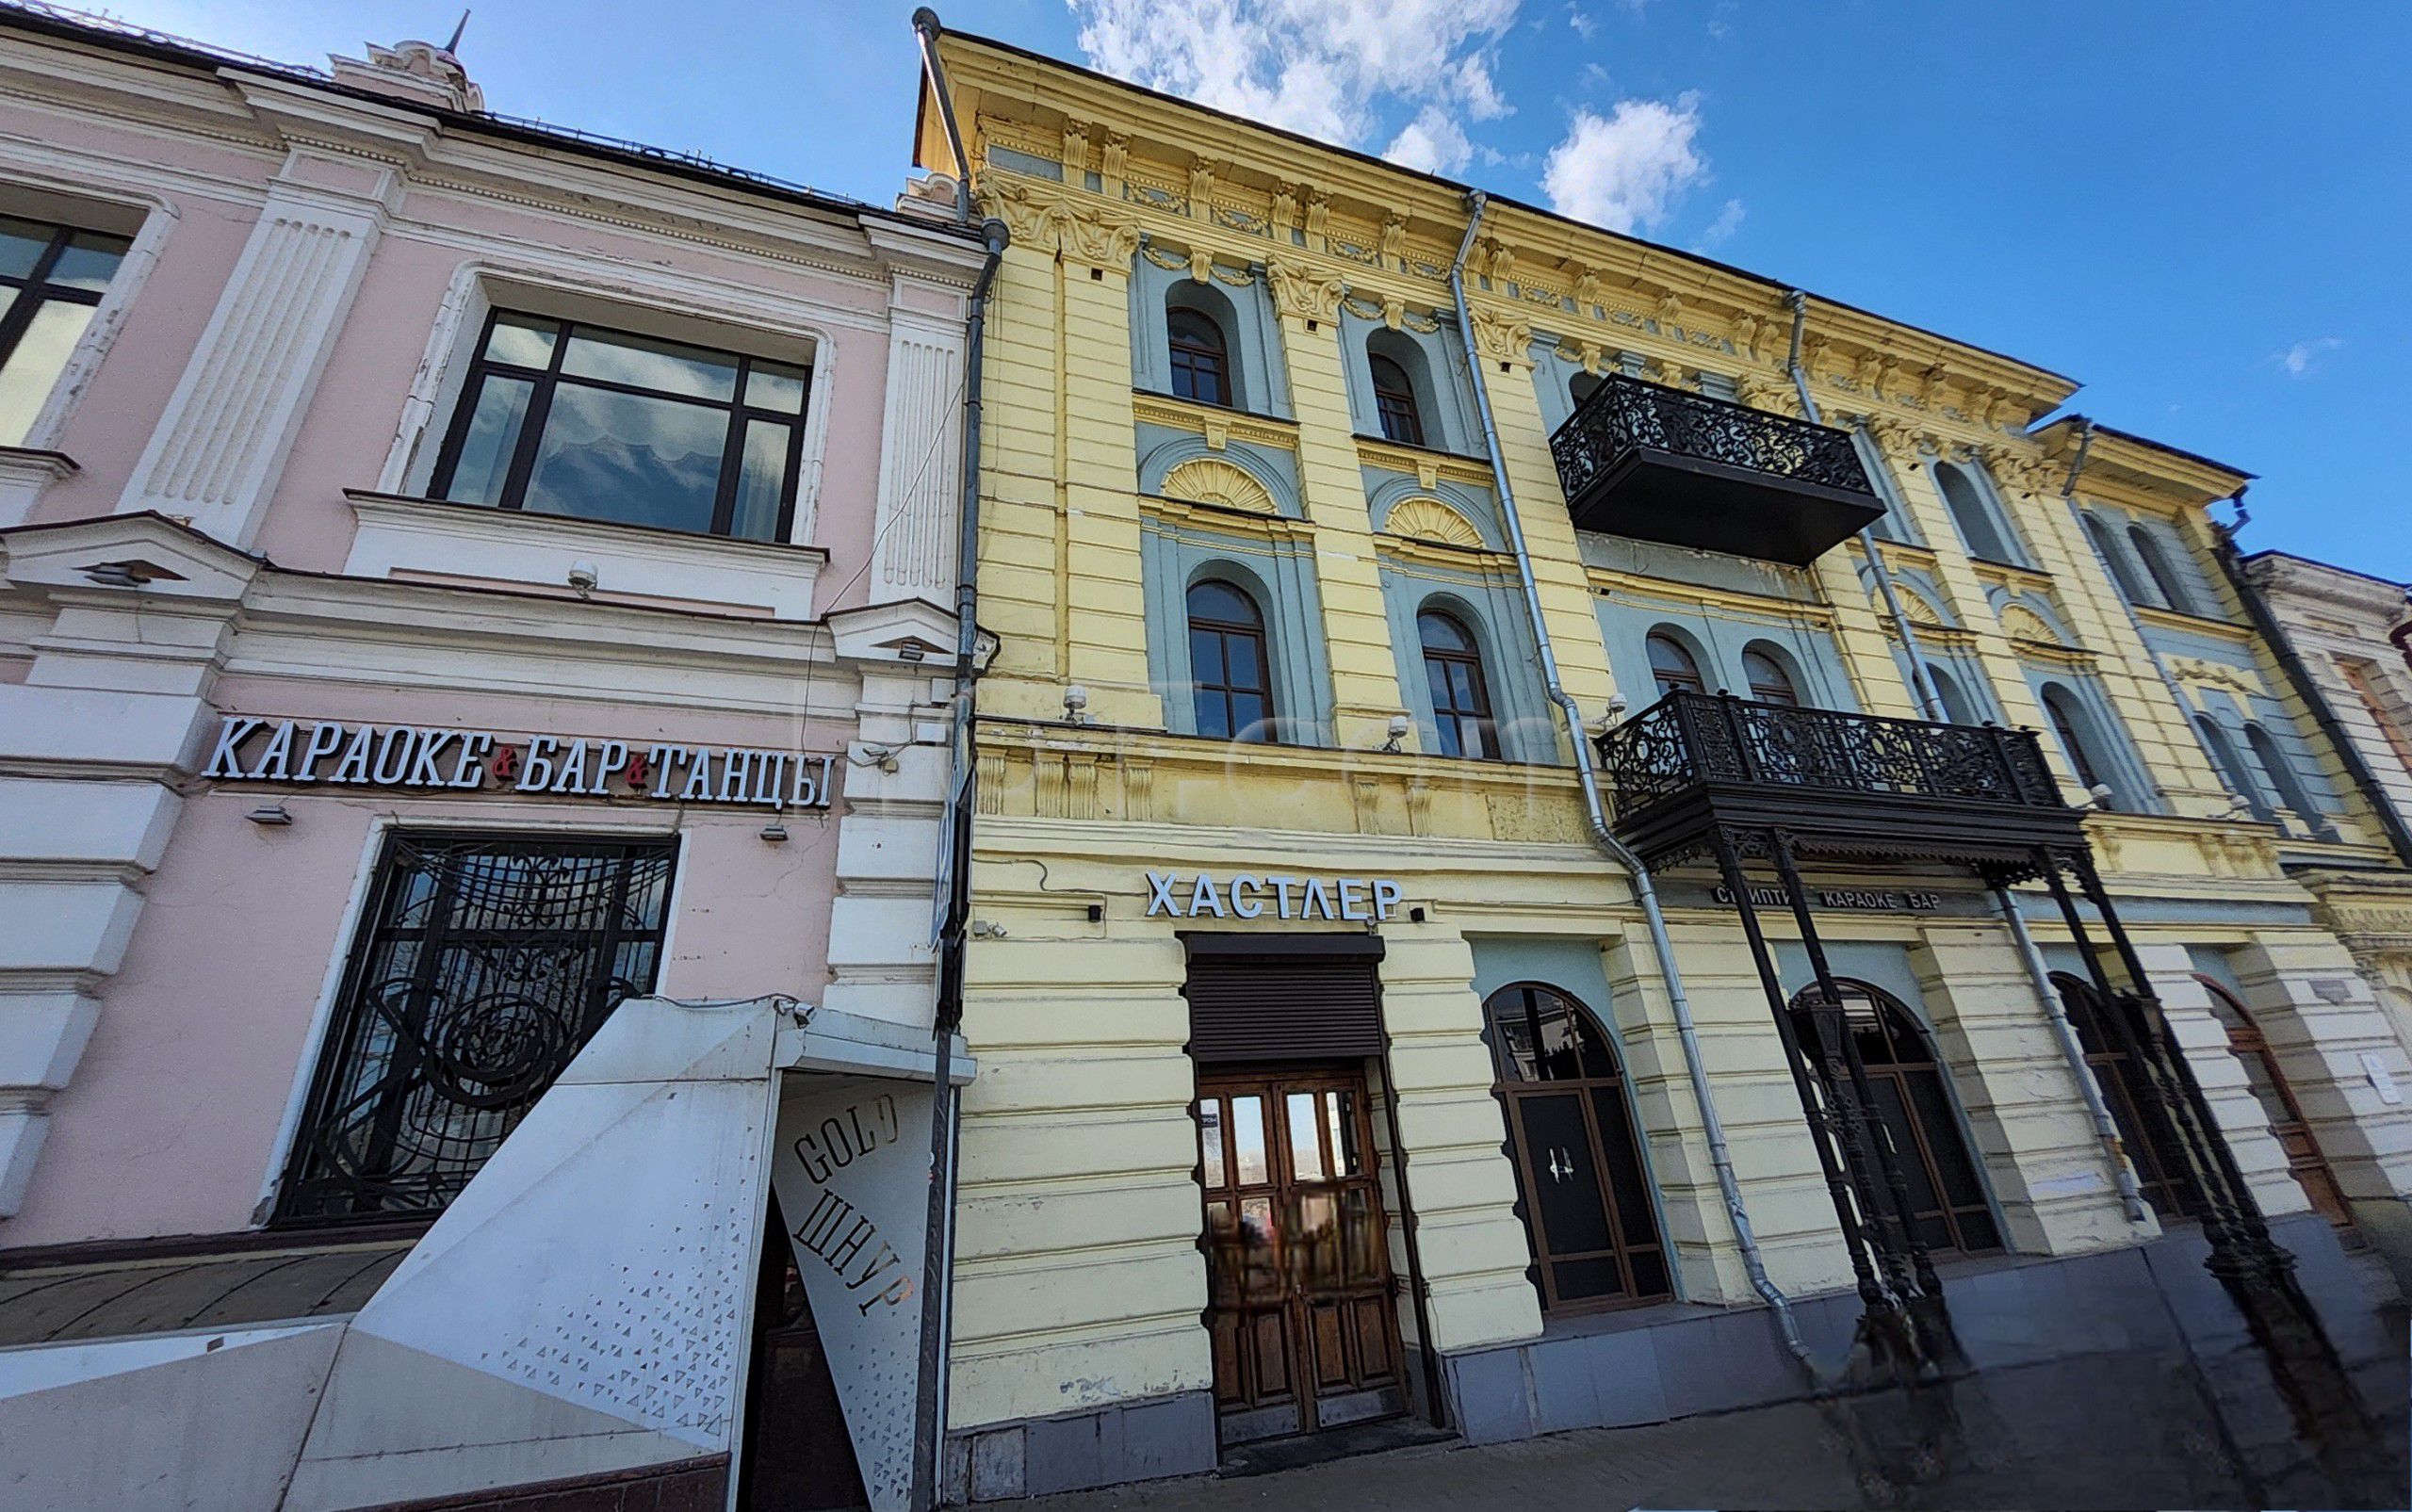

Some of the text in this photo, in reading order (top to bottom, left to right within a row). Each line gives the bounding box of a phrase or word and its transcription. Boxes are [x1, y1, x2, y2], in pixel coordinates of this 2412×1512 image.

[201, 716, 494, 789] КАРАОКЕ
[514, 734, 628, 795] БАР
[648, 743, 836, 810] ТАНЦЫ
[1145, 871, 1404, 921] ХАСТЛЕР
[1823, 890, 1898, 909] КАРАОКЕ
[1910, 893, 1941, 909] БАР
[793, 1094, 898, 1184] GOLD
[792, 1188, 914, 1317] ШНУР
